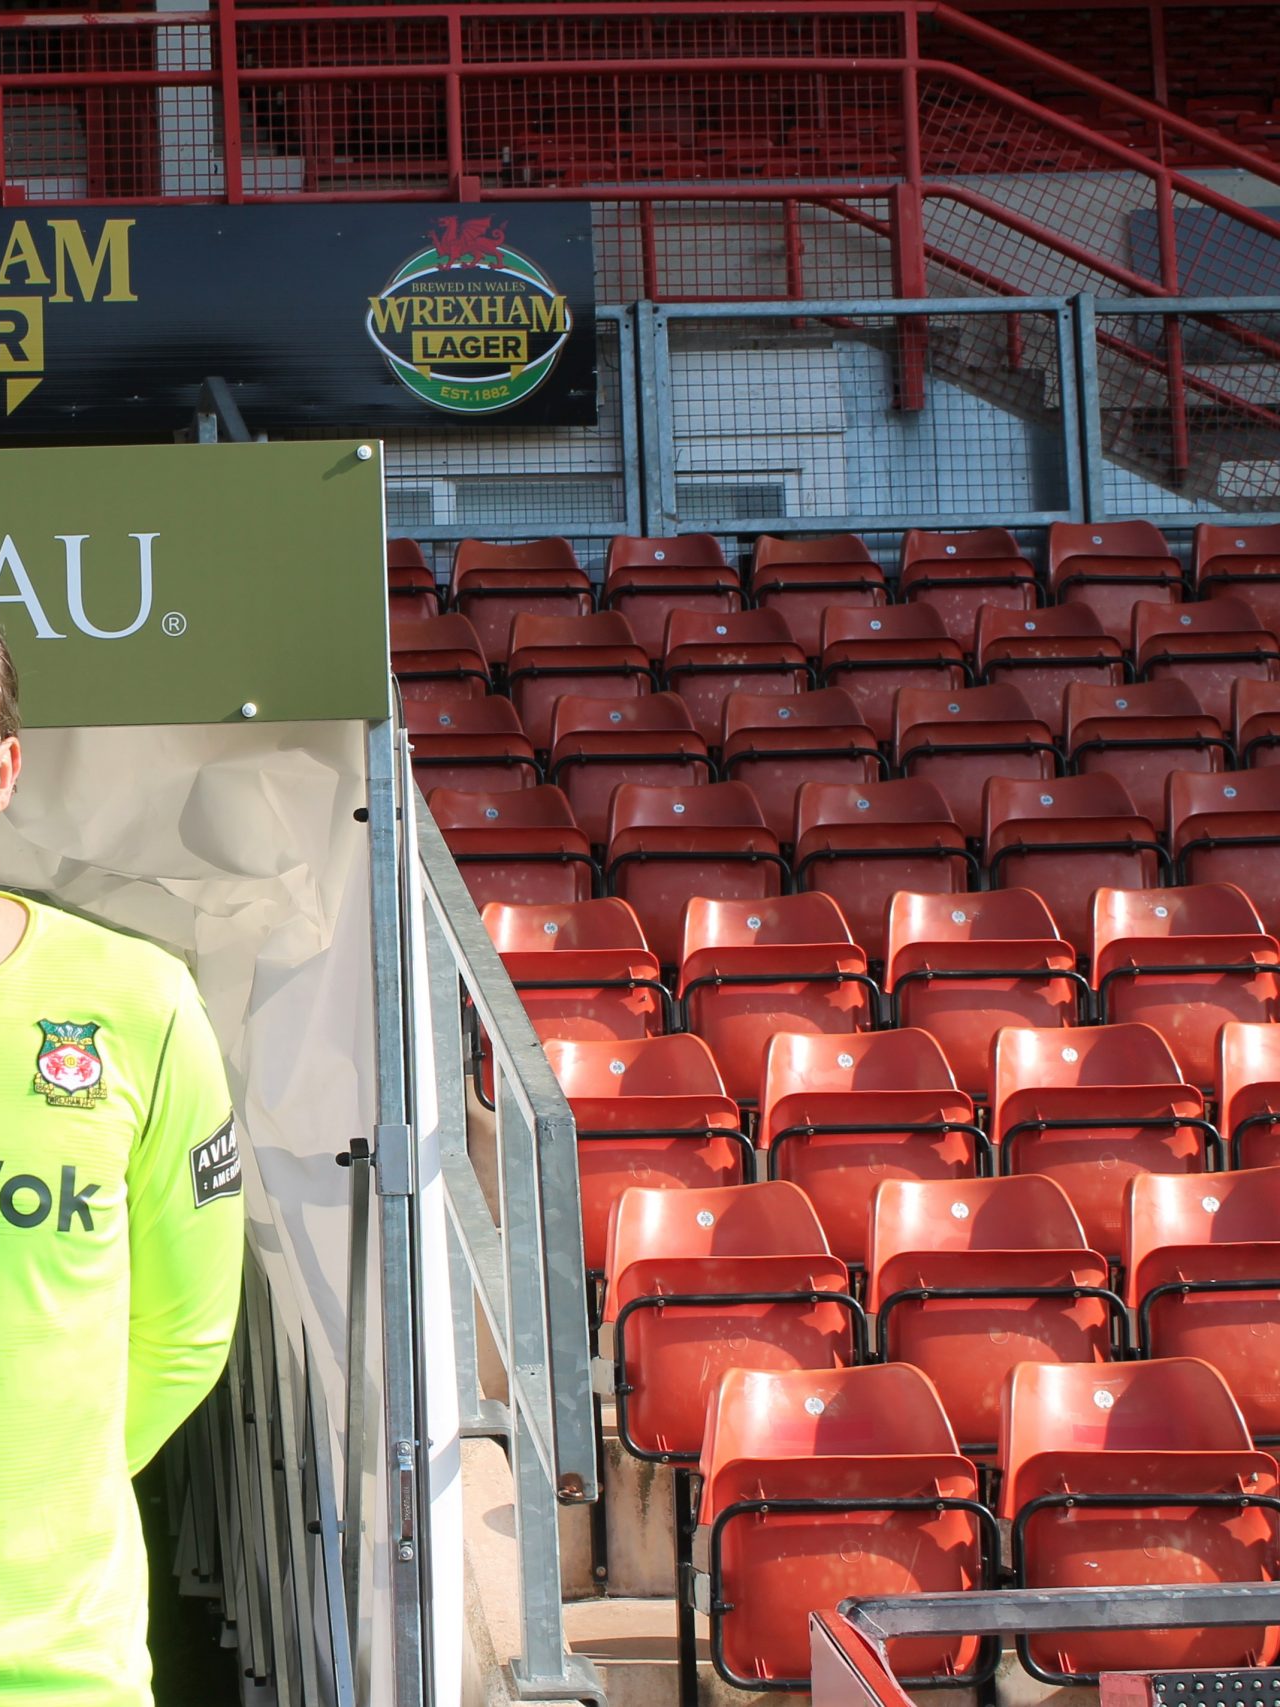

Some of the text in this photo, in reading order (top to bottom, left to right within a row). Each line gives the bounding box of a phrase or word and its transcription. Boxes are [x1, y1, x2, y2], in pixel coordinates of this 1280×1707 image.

[411, 281, 526, 293] BREWED IN WALES
[367, 295, 568, 334] WREXHAM
[422, 336, 522, 359] LAGER
